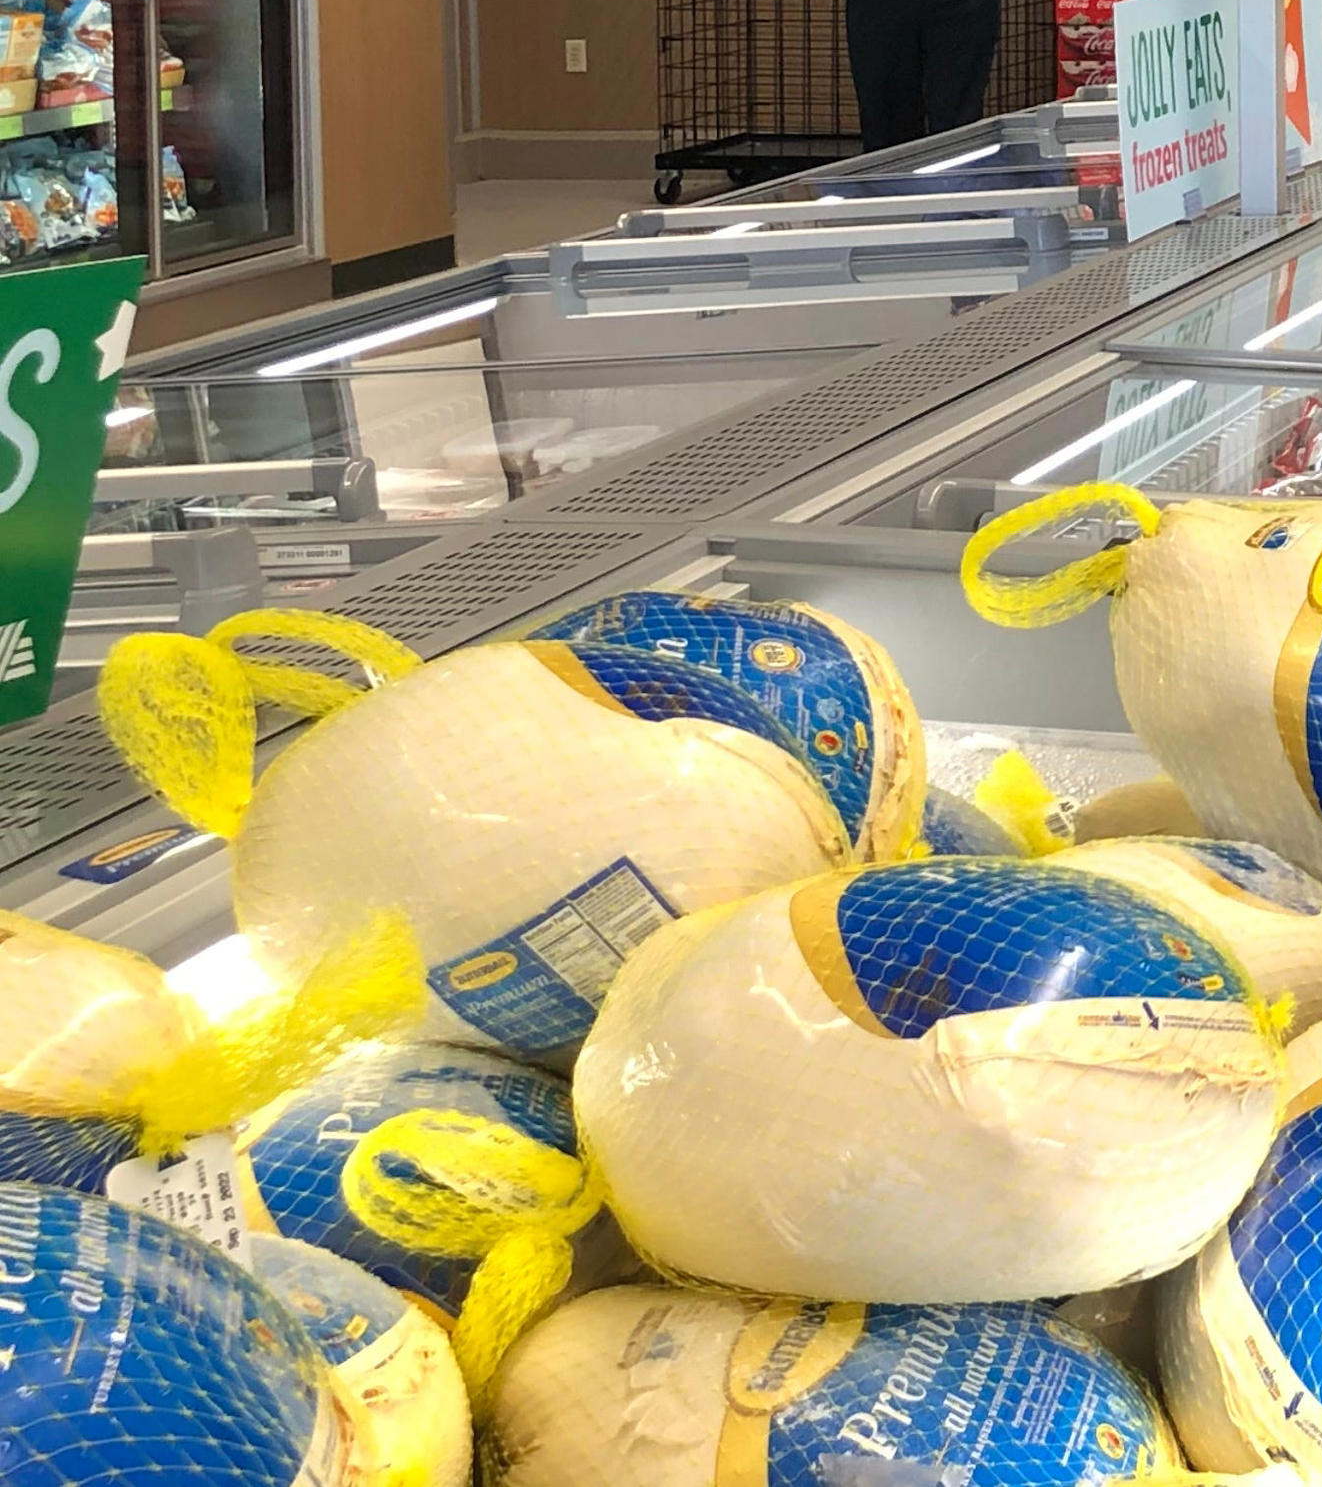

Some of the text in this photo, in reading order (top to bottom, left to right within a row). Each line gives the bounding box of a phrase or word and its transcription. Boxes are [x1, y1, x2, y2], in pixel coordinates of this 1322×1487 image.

[1127, 24, 1176, 129] JOLLY
[1132, 119, 1228, 194] frozen treats
[215, 1171, 233, 1201] 2022
[221, 1205, 236, 1222] 23
[60, 1270, 104, 1313] all
[839, 1302, 963, 1460] Premiu
[943, 1392, 975, 1435] all
